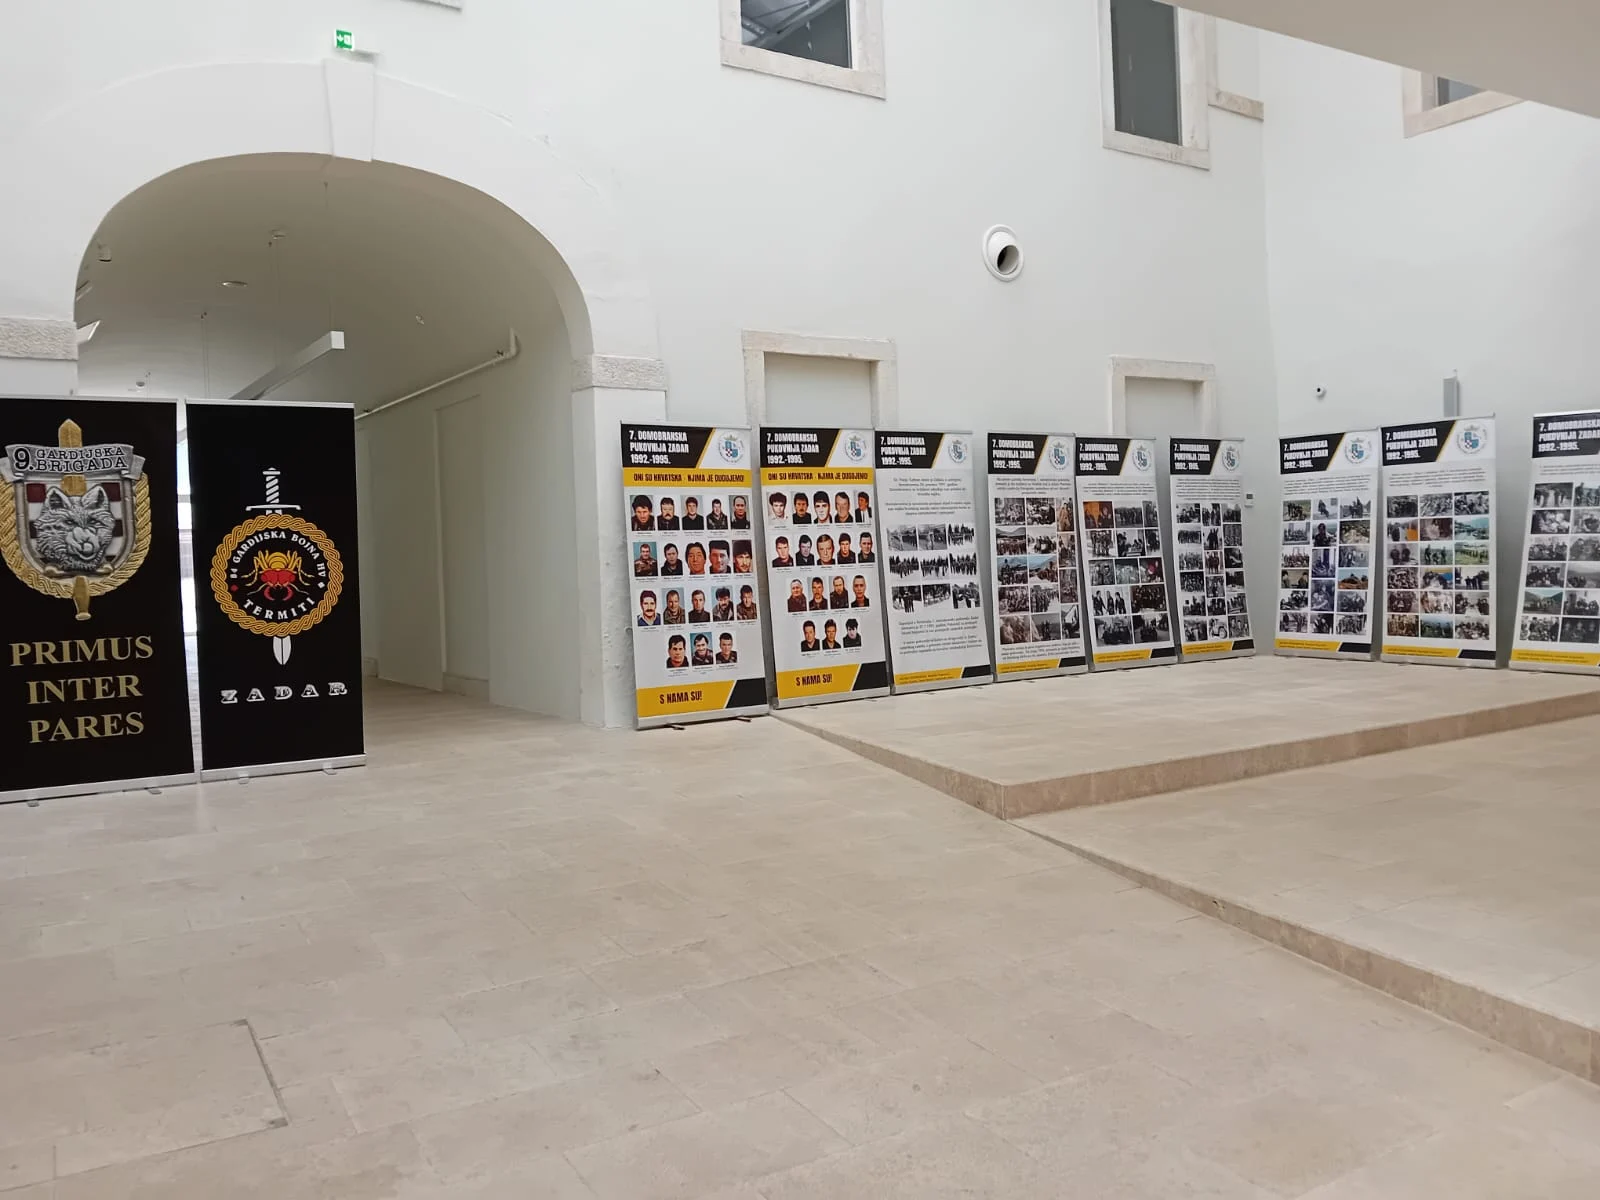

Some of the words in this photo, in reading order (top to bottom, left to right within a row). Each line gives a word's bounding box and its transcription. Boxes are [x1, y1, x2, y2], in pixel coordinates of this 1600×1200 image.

[1539, 422, 1547, 432] 7.
[629, 430, 637, 441] 7.
[638, 430, 687, 443] DOMOBRANSKA
[766, 433, 774, 443] 7.
[880, 436, 886, 446] 7.
[1386, 432, 1392, 441] 7.
[630, 442, 667, 453] PUKOVNIJA
[668, 443, 689, 454] ZADAR
[14, 446, 35, 472] 9.
[36, 447, 125, 460] GARDIJSKA
[35, 456, 127, 473] BRIGADA
[630, 454, 671, 465] 1992.-1995.
[634, 473, 643, 482] ONI
[707, 474, 714, 483] JE
[232, 531, 286, 564] GARDIJSKA
[291, 533, 320, 560] BOJNA
[317, 563, 326, 577] HV
[243, 597, 316, 620] TERMITI
[9, 634, 155, 668] PRIMUS
[796, 677, 801, 687] S
[802, 674, 821, 686] NAMA
[26, 674, 143, 706] INTER
[220, 681, 349, 705] ZADAR
[659, 694, 665, 704] S
[667, 692, 689, 704] NAMA
[691, 690, 703, 701] SU!
[28, 711, 145, 744] PARES
